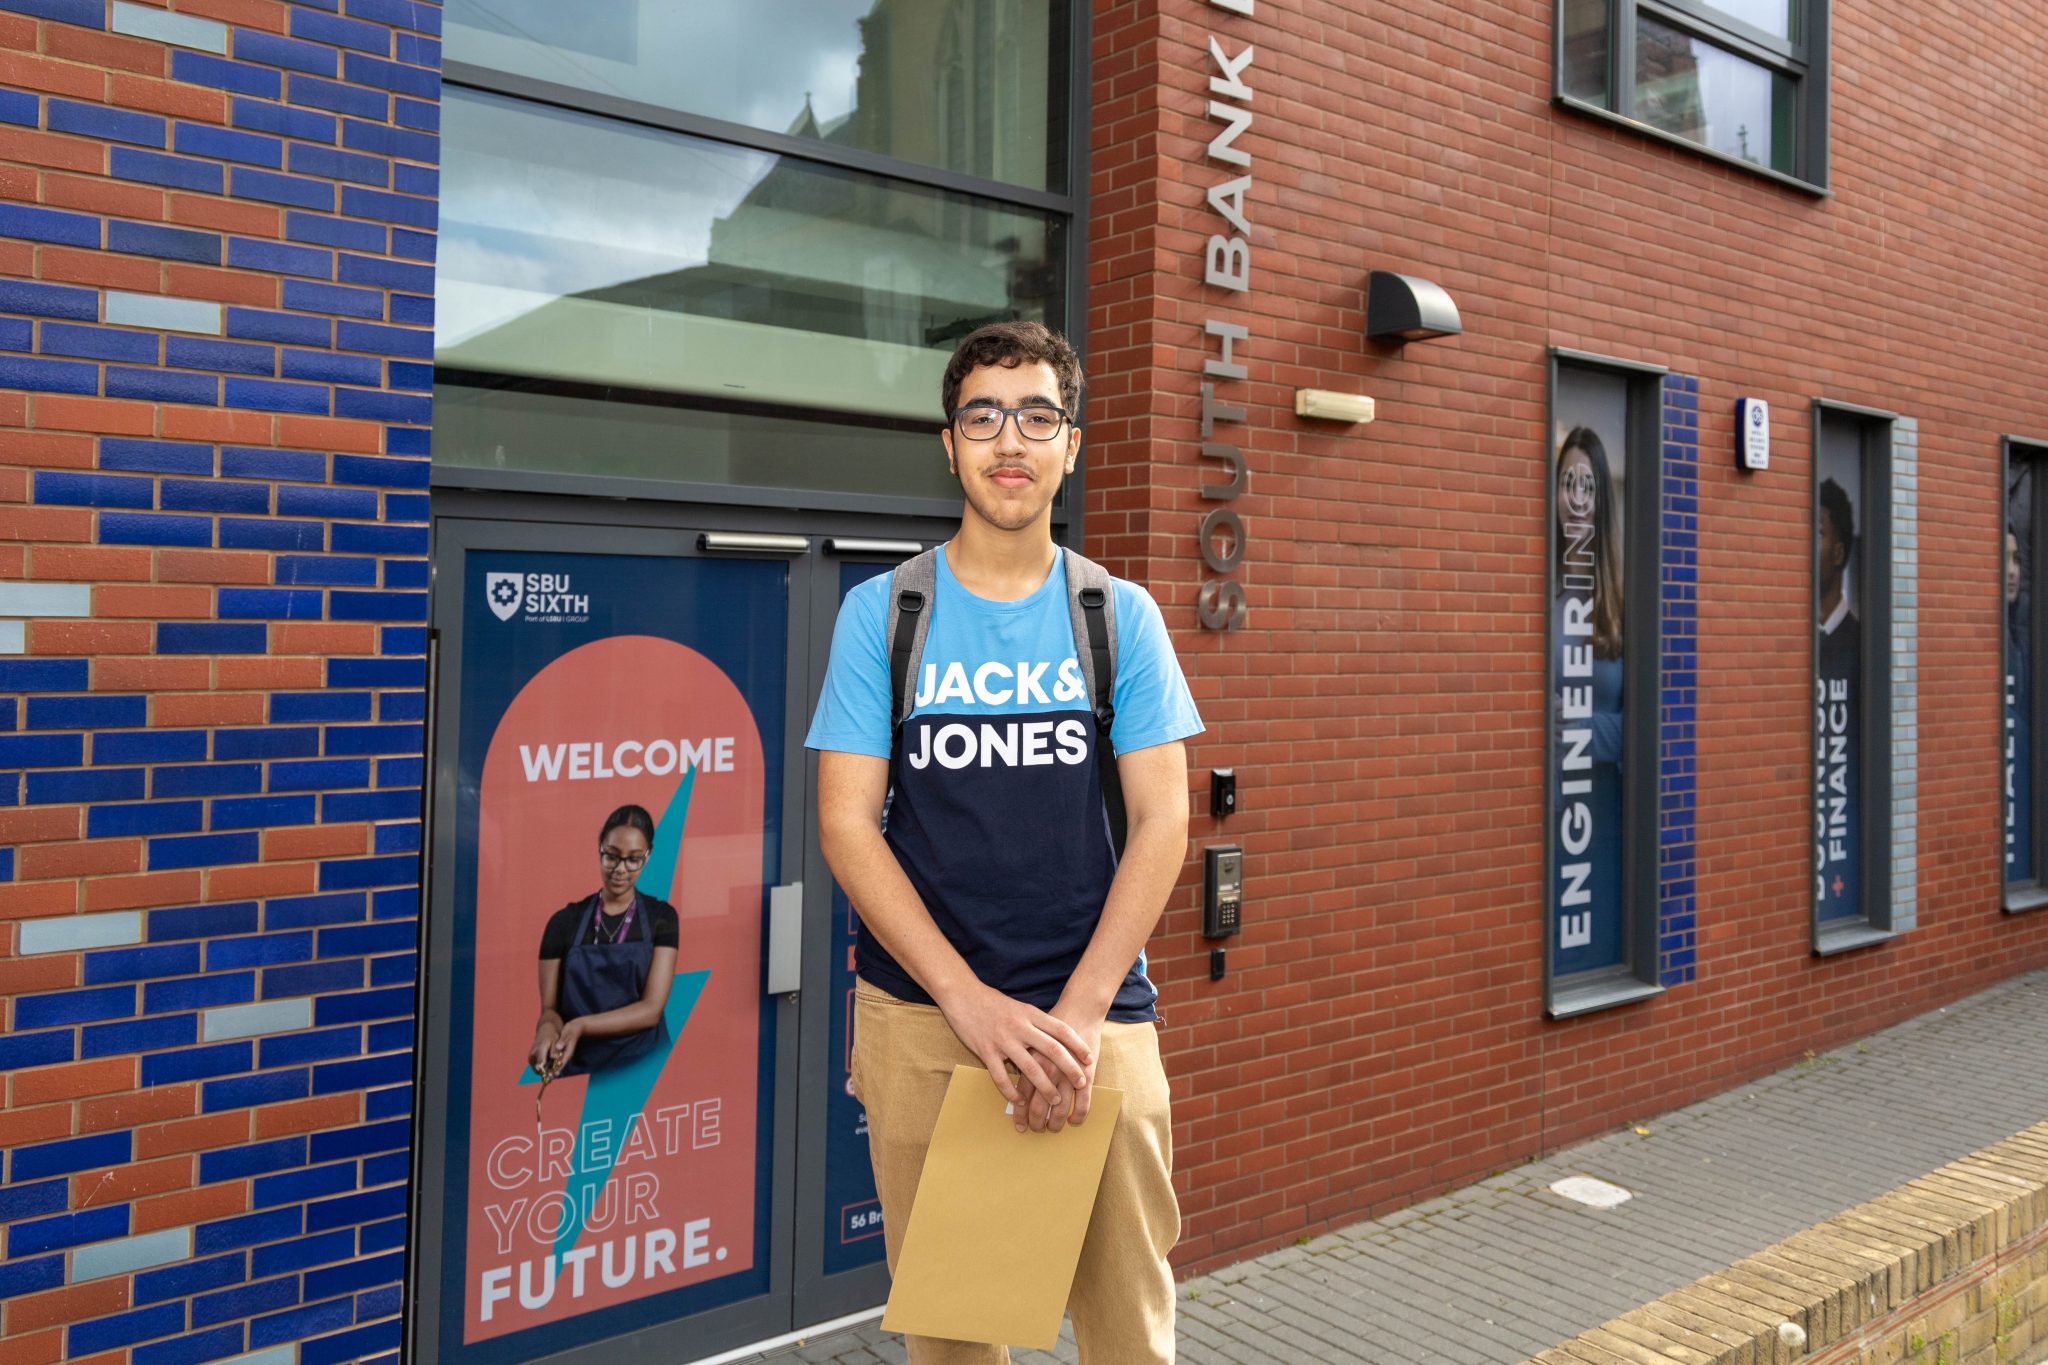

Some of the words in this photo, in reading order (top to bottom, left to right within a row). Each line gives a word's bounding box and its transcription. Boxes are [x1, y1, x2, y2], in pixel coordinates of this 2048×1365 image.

[1206, 35, 1254, 292] BANK
[1200, 319, 1248, 631] SOUTH
[525, 594, 589, 614] SIXTH
[526, 573, 570, 593] SBU
[908, 719, 1088, 770] JONES
[1560, 463, 1595, 949] ENGINEERING
[519, 737, 735, 782] WELCOME
[1828, 678, 1848, 861] FINANCE
[487, 1098, 721, 1190] CREATE
[484, 1172, 660, 1254] YOUR
[851, 1213, 866, 1229] 56
[480, 1217, 728, 1322] FUTURE.
